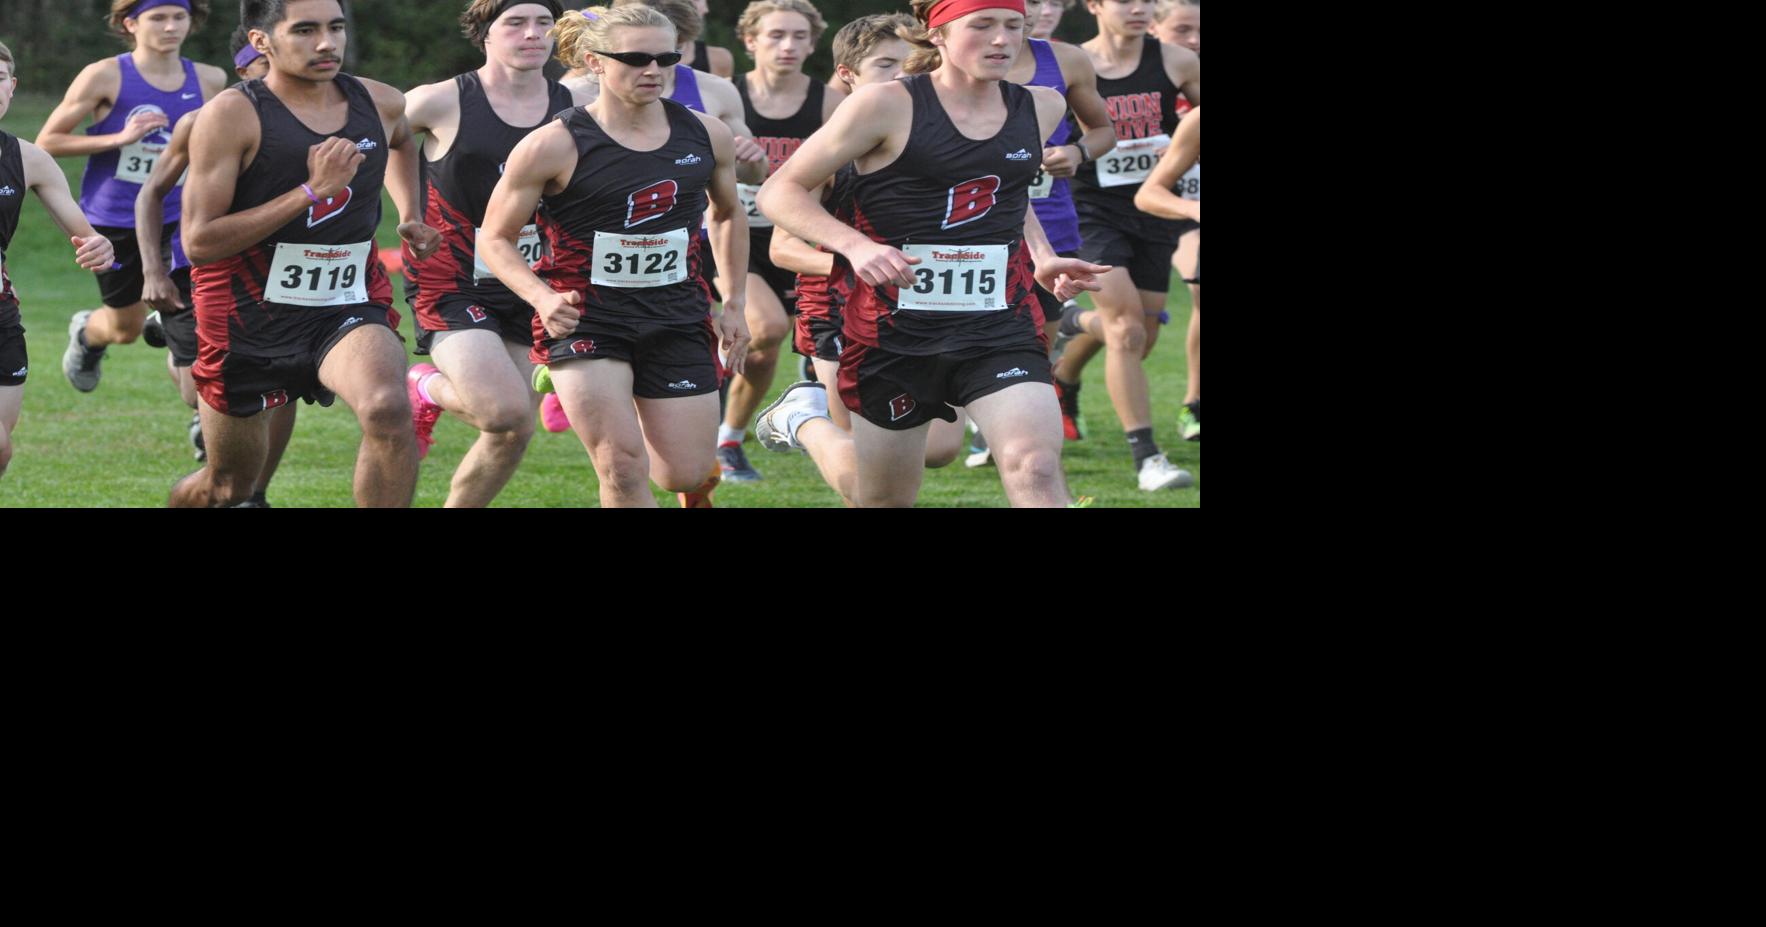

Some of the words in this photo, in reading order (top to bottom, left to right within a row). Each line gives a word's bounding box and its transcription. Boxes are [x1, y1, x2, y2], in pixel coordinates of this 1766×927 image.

[1105, 92, 1162, 120] NION
[127, 156, 154, 174] 31
[624, 179, 678, 229] B
[941, 174, 1001, 230] B
[603, 250, 679, 275] 3122
[280, 264, 357, 291] 3119
[913, 268, 996, 294] 3115
